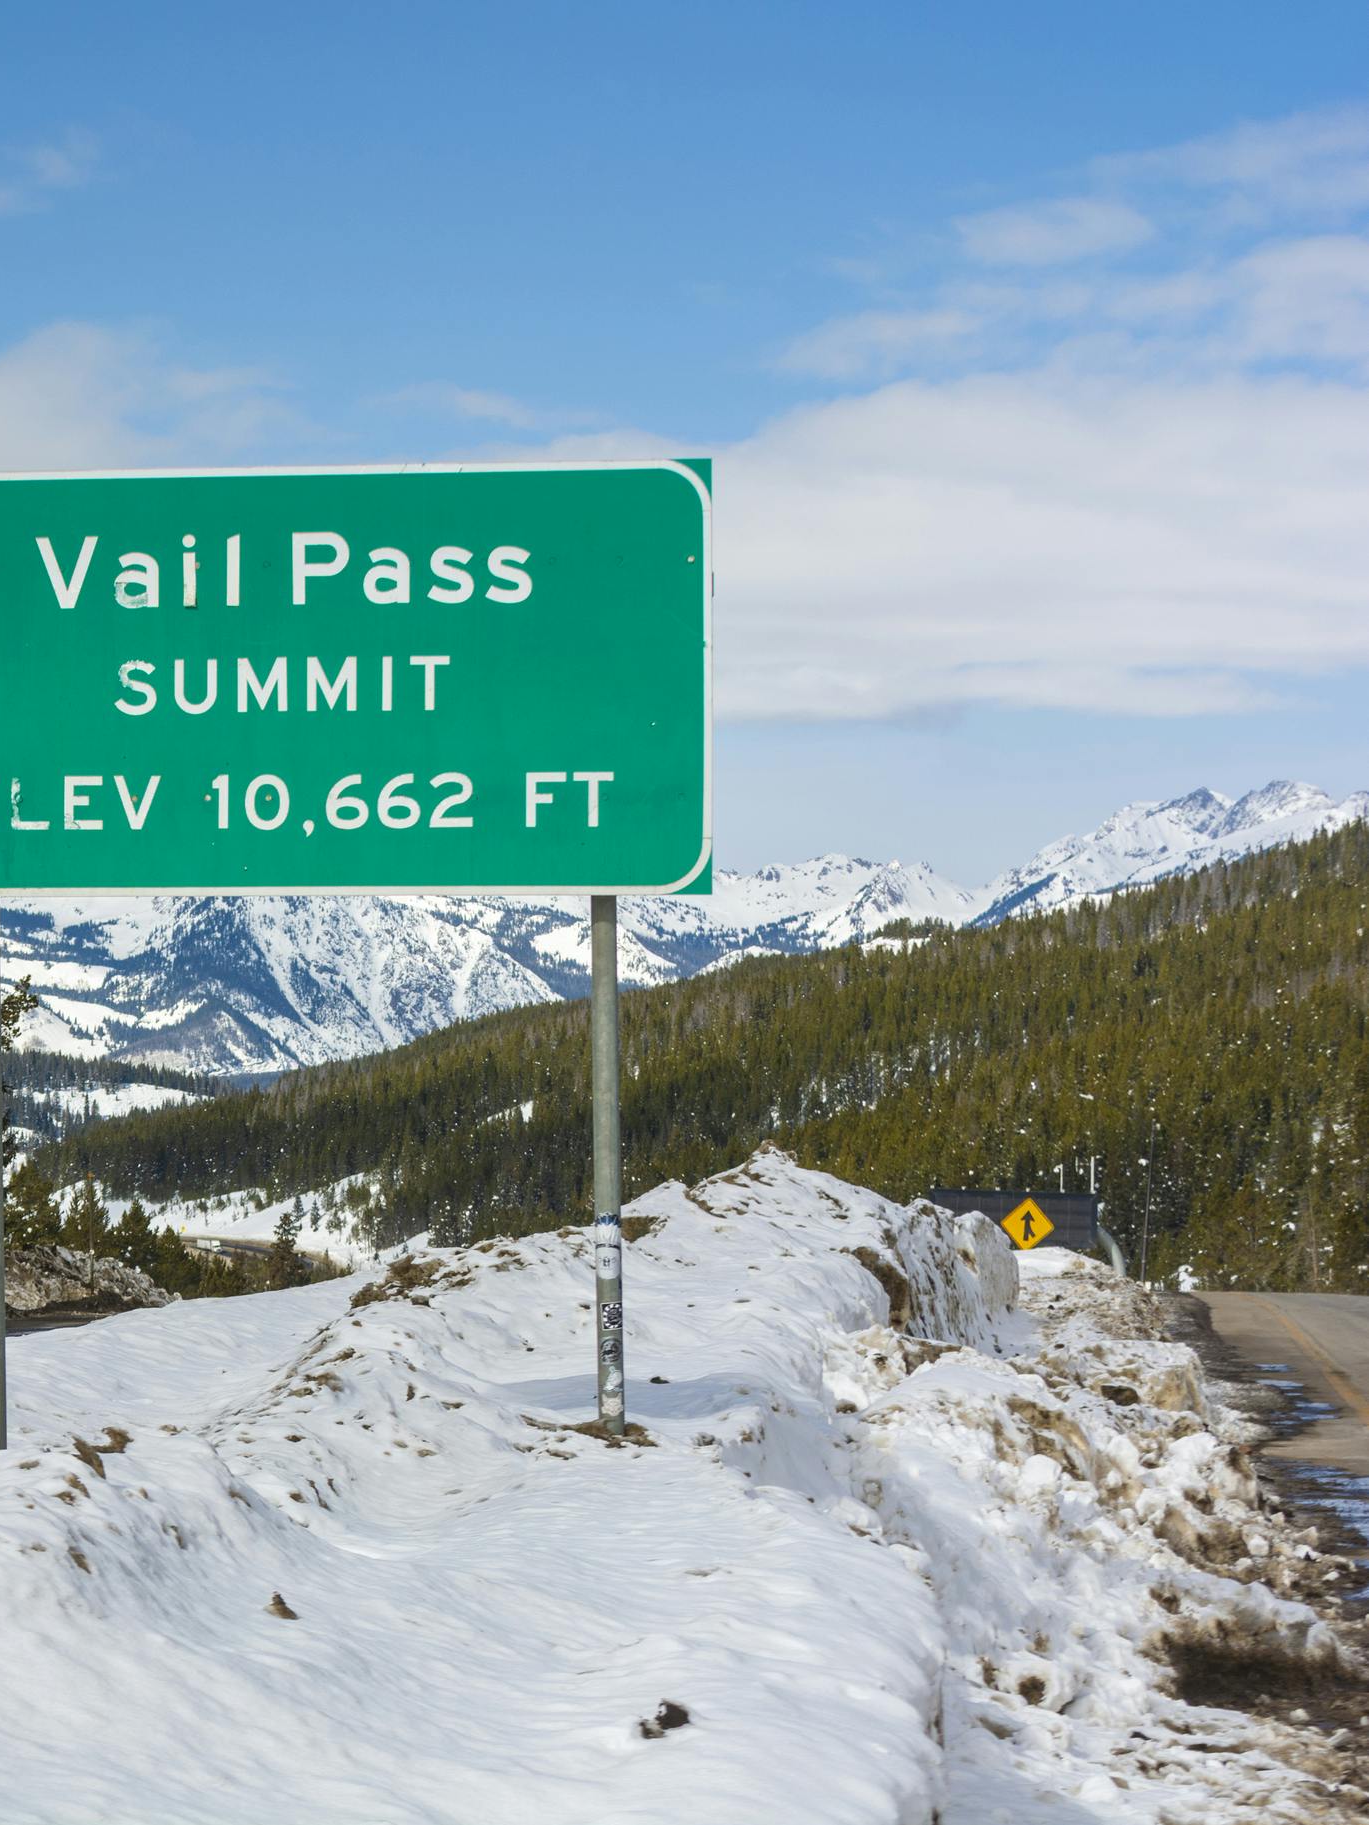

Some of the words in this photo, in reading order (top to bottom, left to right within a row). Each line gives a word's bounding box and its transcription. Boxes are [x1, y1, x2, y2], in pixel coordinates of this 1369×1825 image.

[35, 534, 241, 610] Vail
[291, 531, 534, 606] Pass
[114, 655, 451, 716] SUMMIT
[211, 771, 474, 838] 10,662
[525, 771, 615, 828] FT
